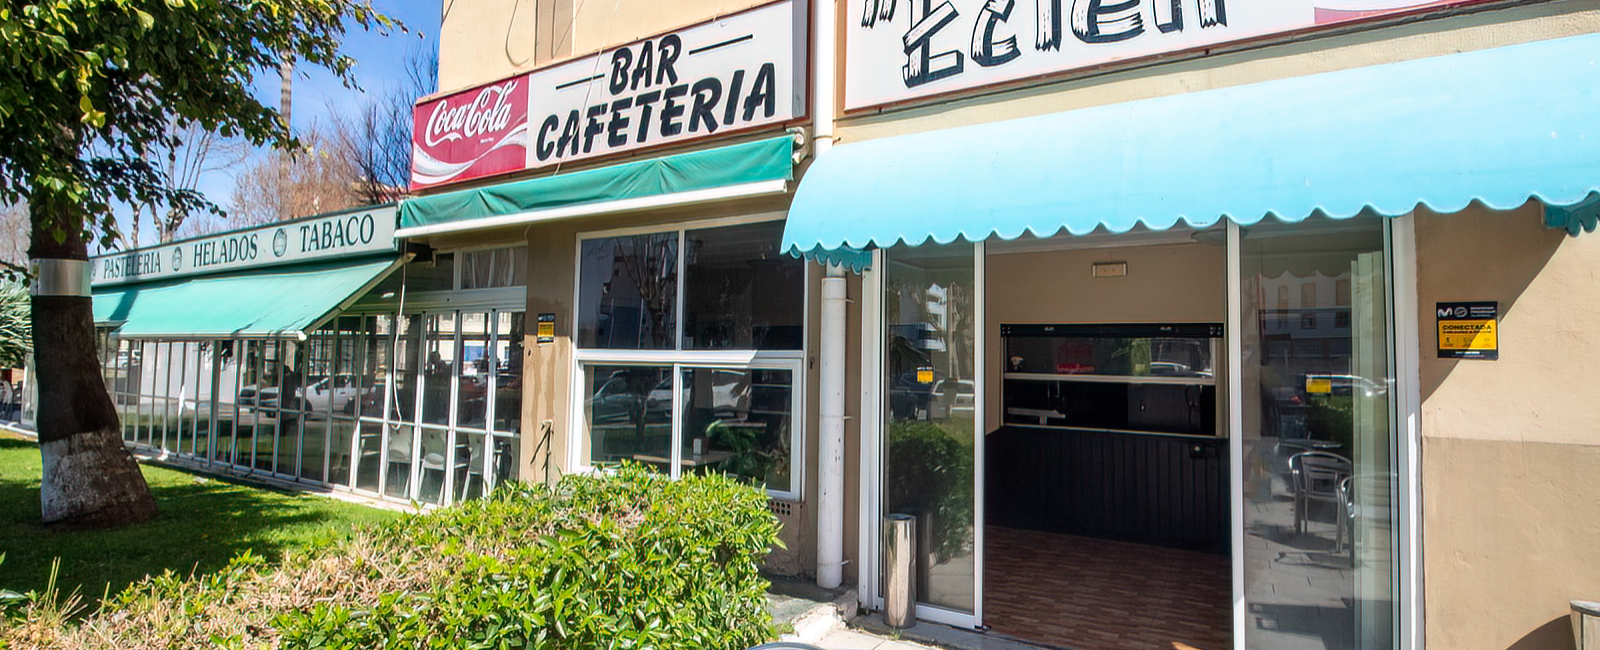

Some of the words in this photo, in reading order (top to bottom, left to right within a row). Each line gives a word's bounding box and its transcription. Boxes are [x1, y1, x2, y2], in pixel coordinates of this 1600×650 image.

[609, 33, 682, 95] BAR
[425, 79, 518, 147] Coca-Cola
[535, 62, 776, 162] CAFETERIA
[103, 252, 161, 279] PASTELERIA
[193, 233, 259, 268] HELADOS
[300, 214, 375, 252] TABACO
